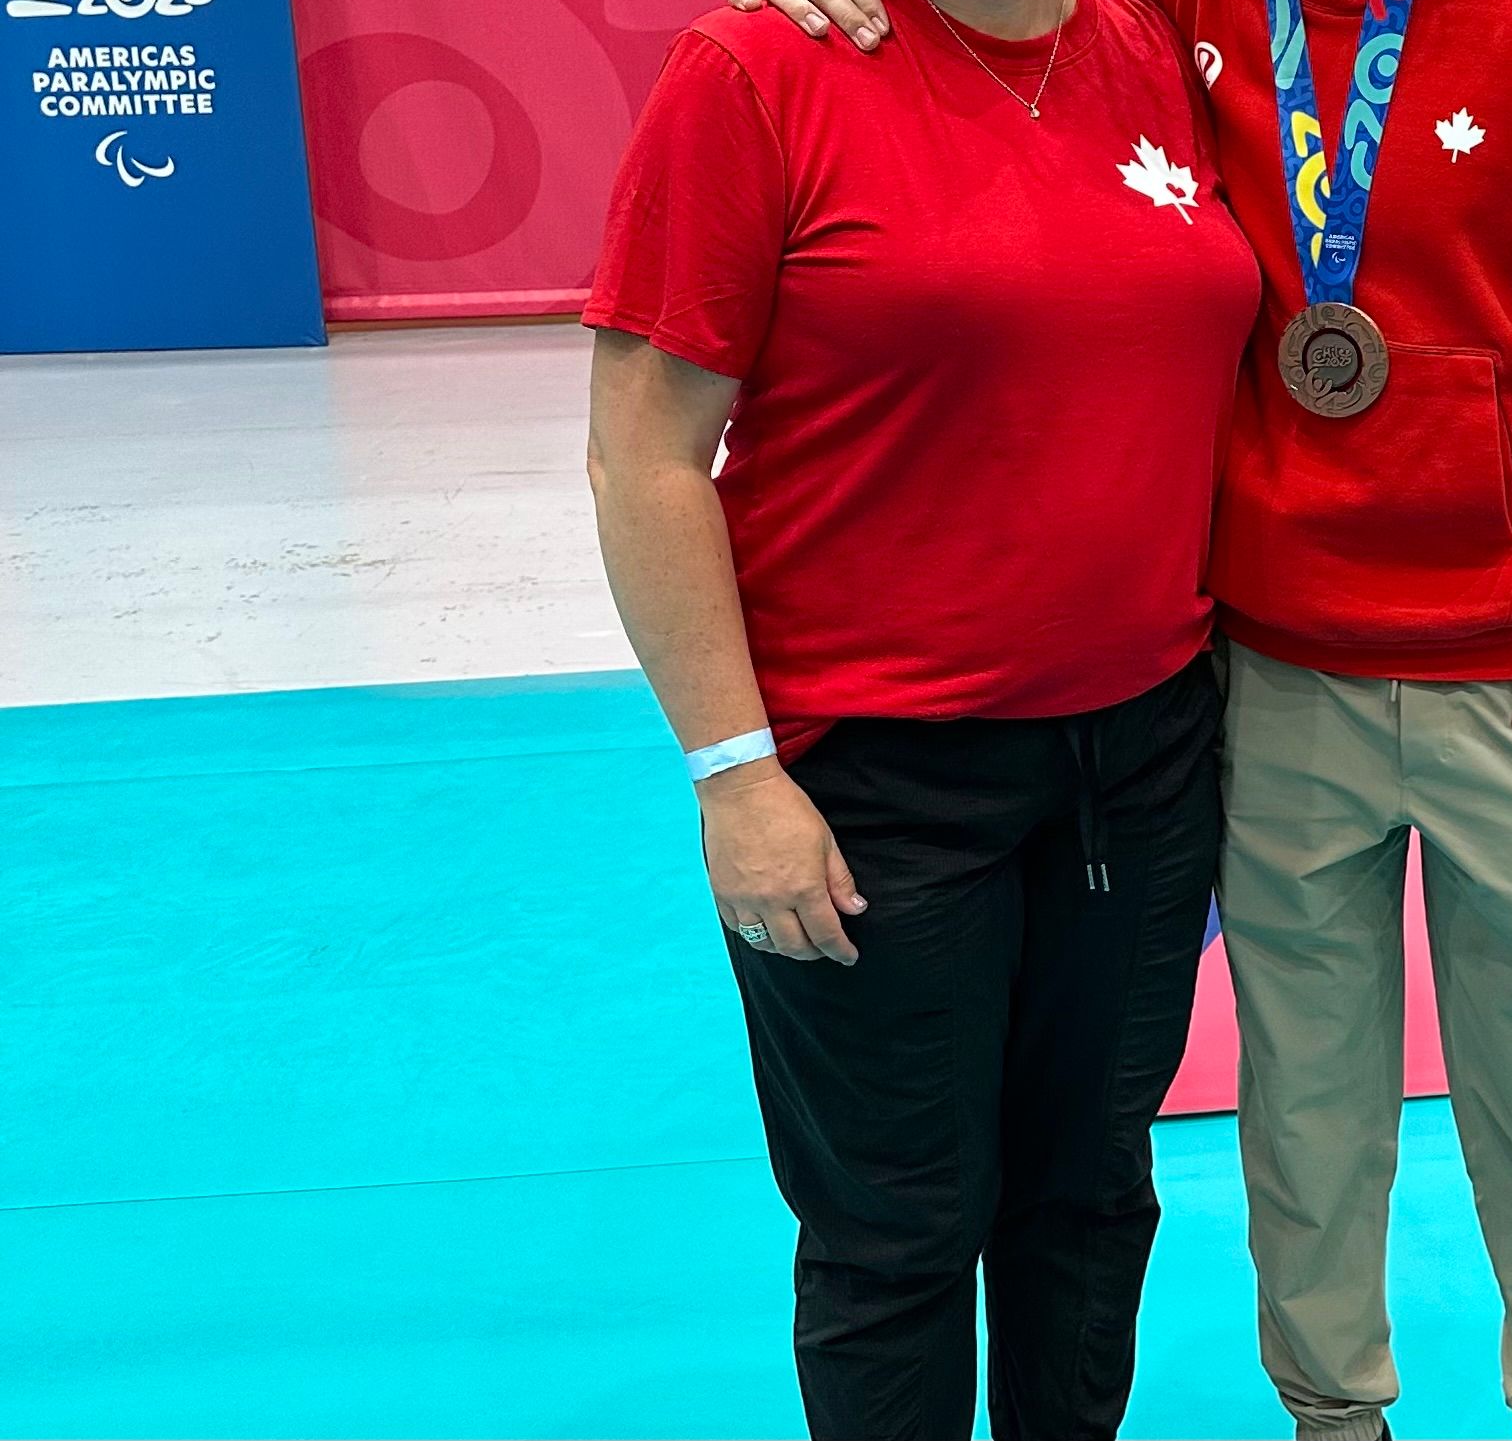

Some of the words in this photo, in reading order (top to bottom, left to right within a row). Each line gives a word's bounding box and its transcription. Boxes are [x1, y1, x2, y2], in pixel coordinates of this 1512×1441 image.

[47, 45, 197, 69] AMERICAS
[32, 69, 217, 93] PARALYMPIC
[39, 93, 214, 117] COMMITTEE
